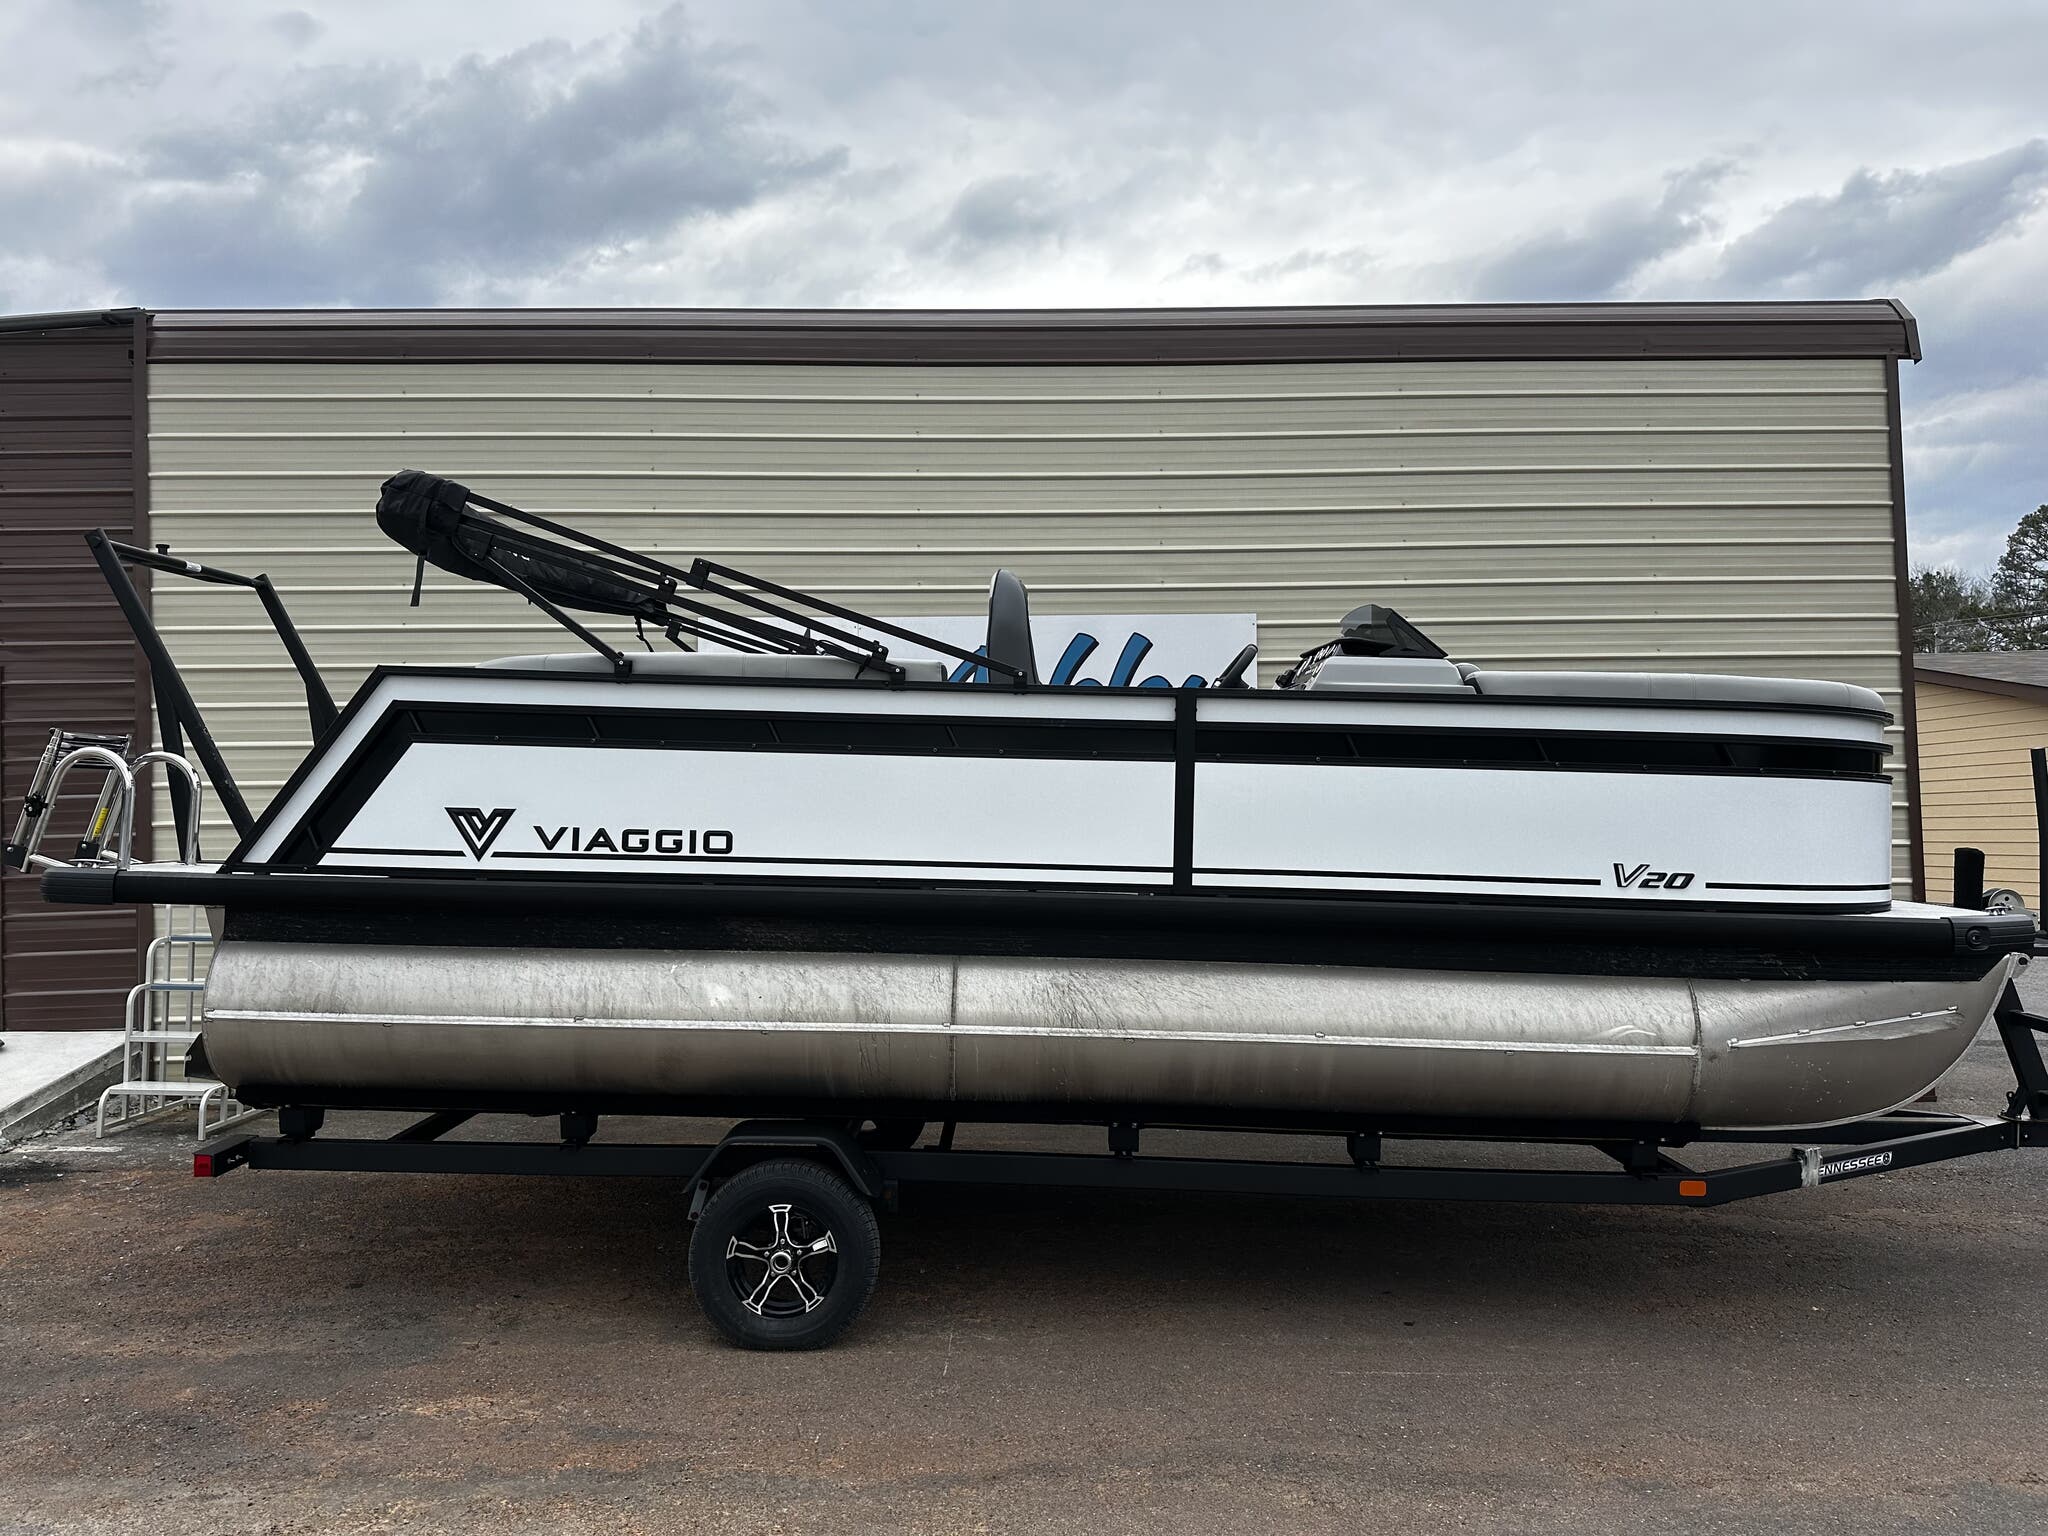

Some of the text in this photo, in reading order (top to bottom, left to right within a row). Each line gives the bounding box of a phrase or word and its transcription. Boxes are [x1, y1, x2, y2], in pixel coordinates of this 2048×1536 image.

[533, 825, 733, 854] VIAGGIO
[1613, 862, 1695, 889] V20
[1818, 1154, 1883, 1177] ENNESSEE
